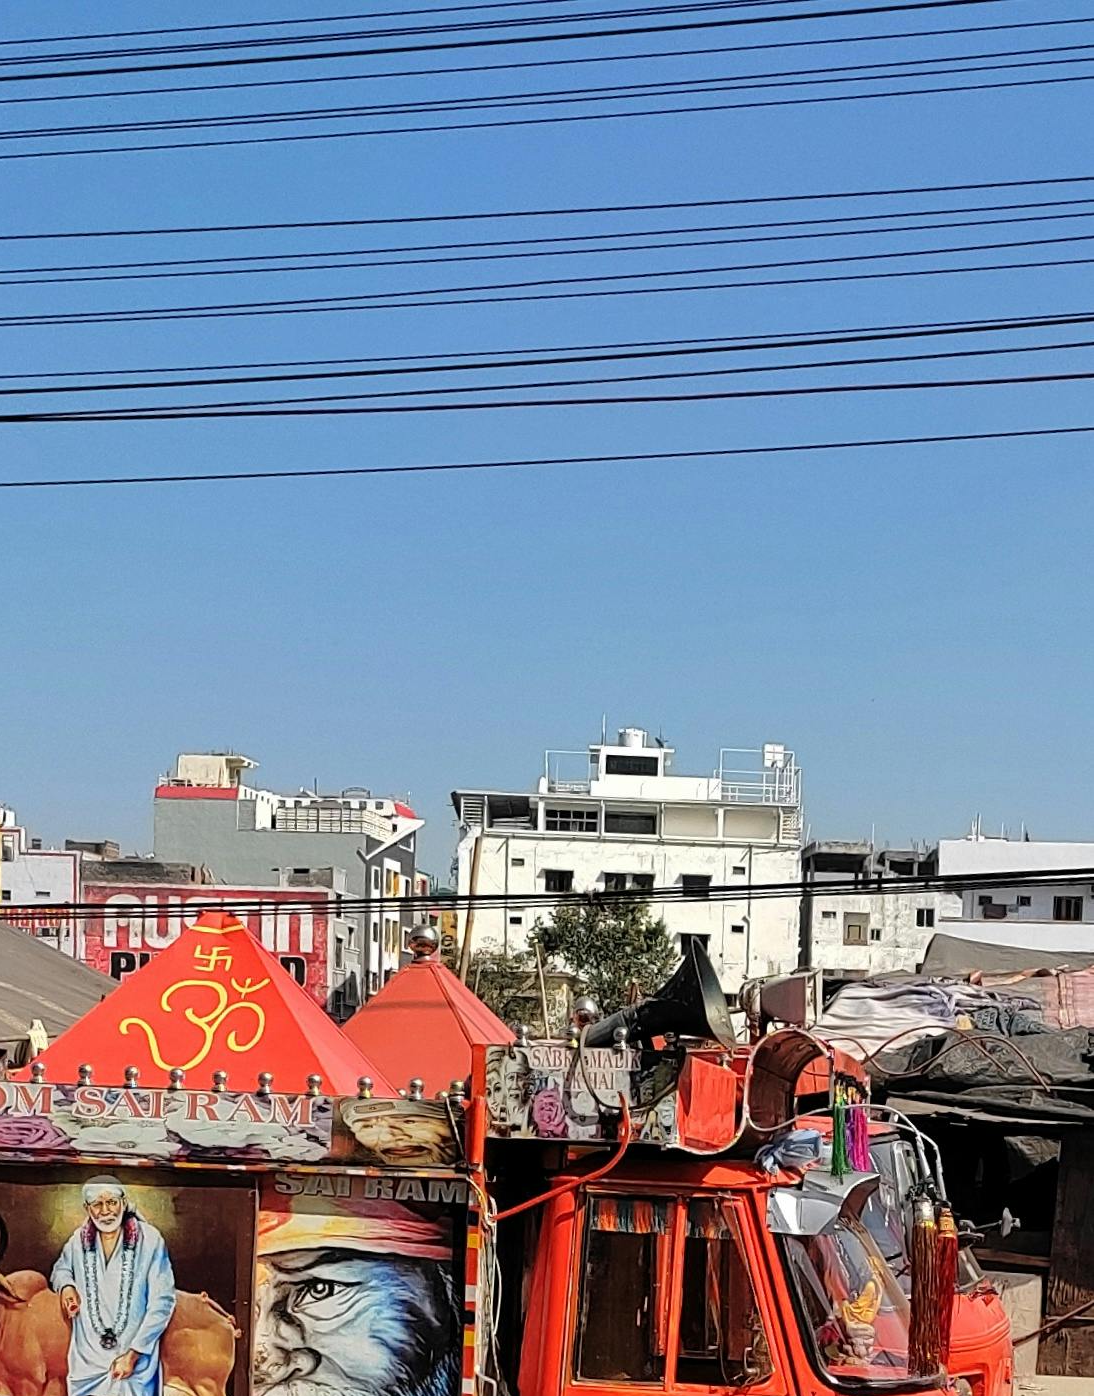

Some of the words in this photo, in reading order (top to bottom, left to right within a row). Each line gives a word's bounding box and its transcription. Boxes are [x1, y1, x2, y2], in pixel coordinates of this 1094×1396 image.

[532, 1048, 587, 1068] SABK
[73, 1085, 166, 1121] SAI
[185, 1092, 316, 1129] RAM
[275, 1173, 352, 1198] SAI
[365, 1177, 468, 1204] RAM
